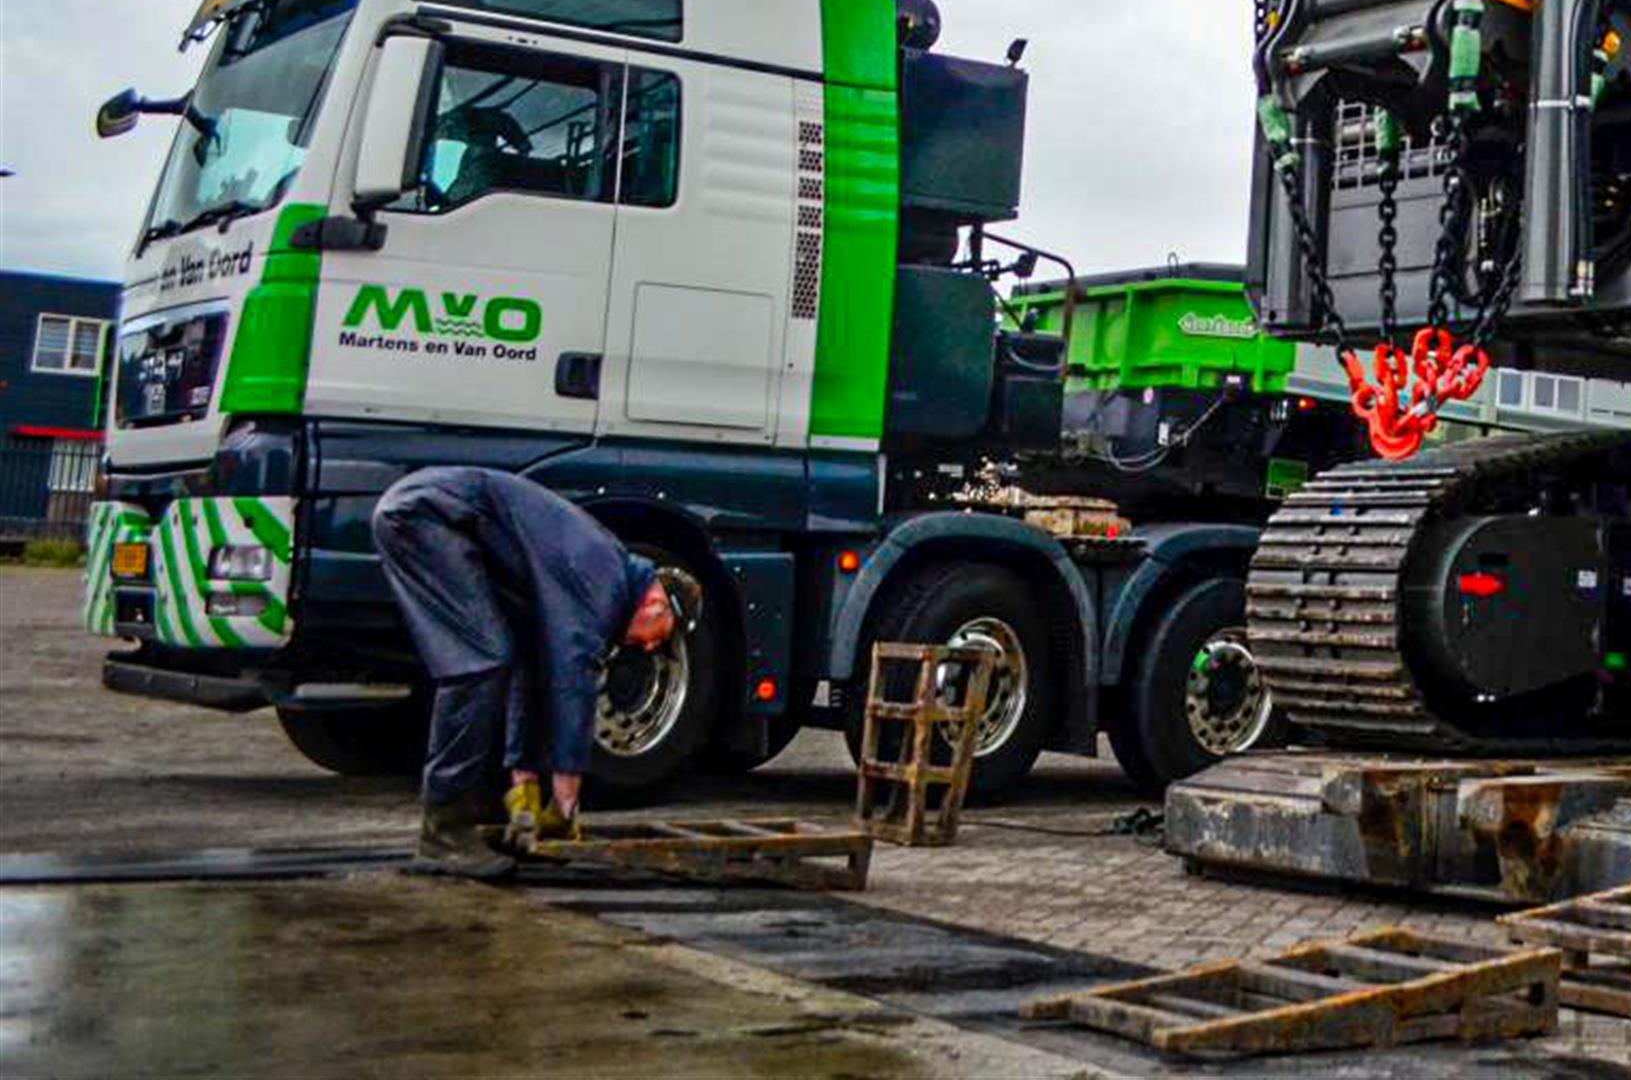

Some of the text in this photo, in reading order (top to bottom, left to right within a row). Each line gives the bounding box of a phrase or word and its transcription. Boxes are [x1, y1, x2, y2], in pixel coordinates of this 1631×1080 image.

[339, 331, 537, 361] Martens en Van Oord
